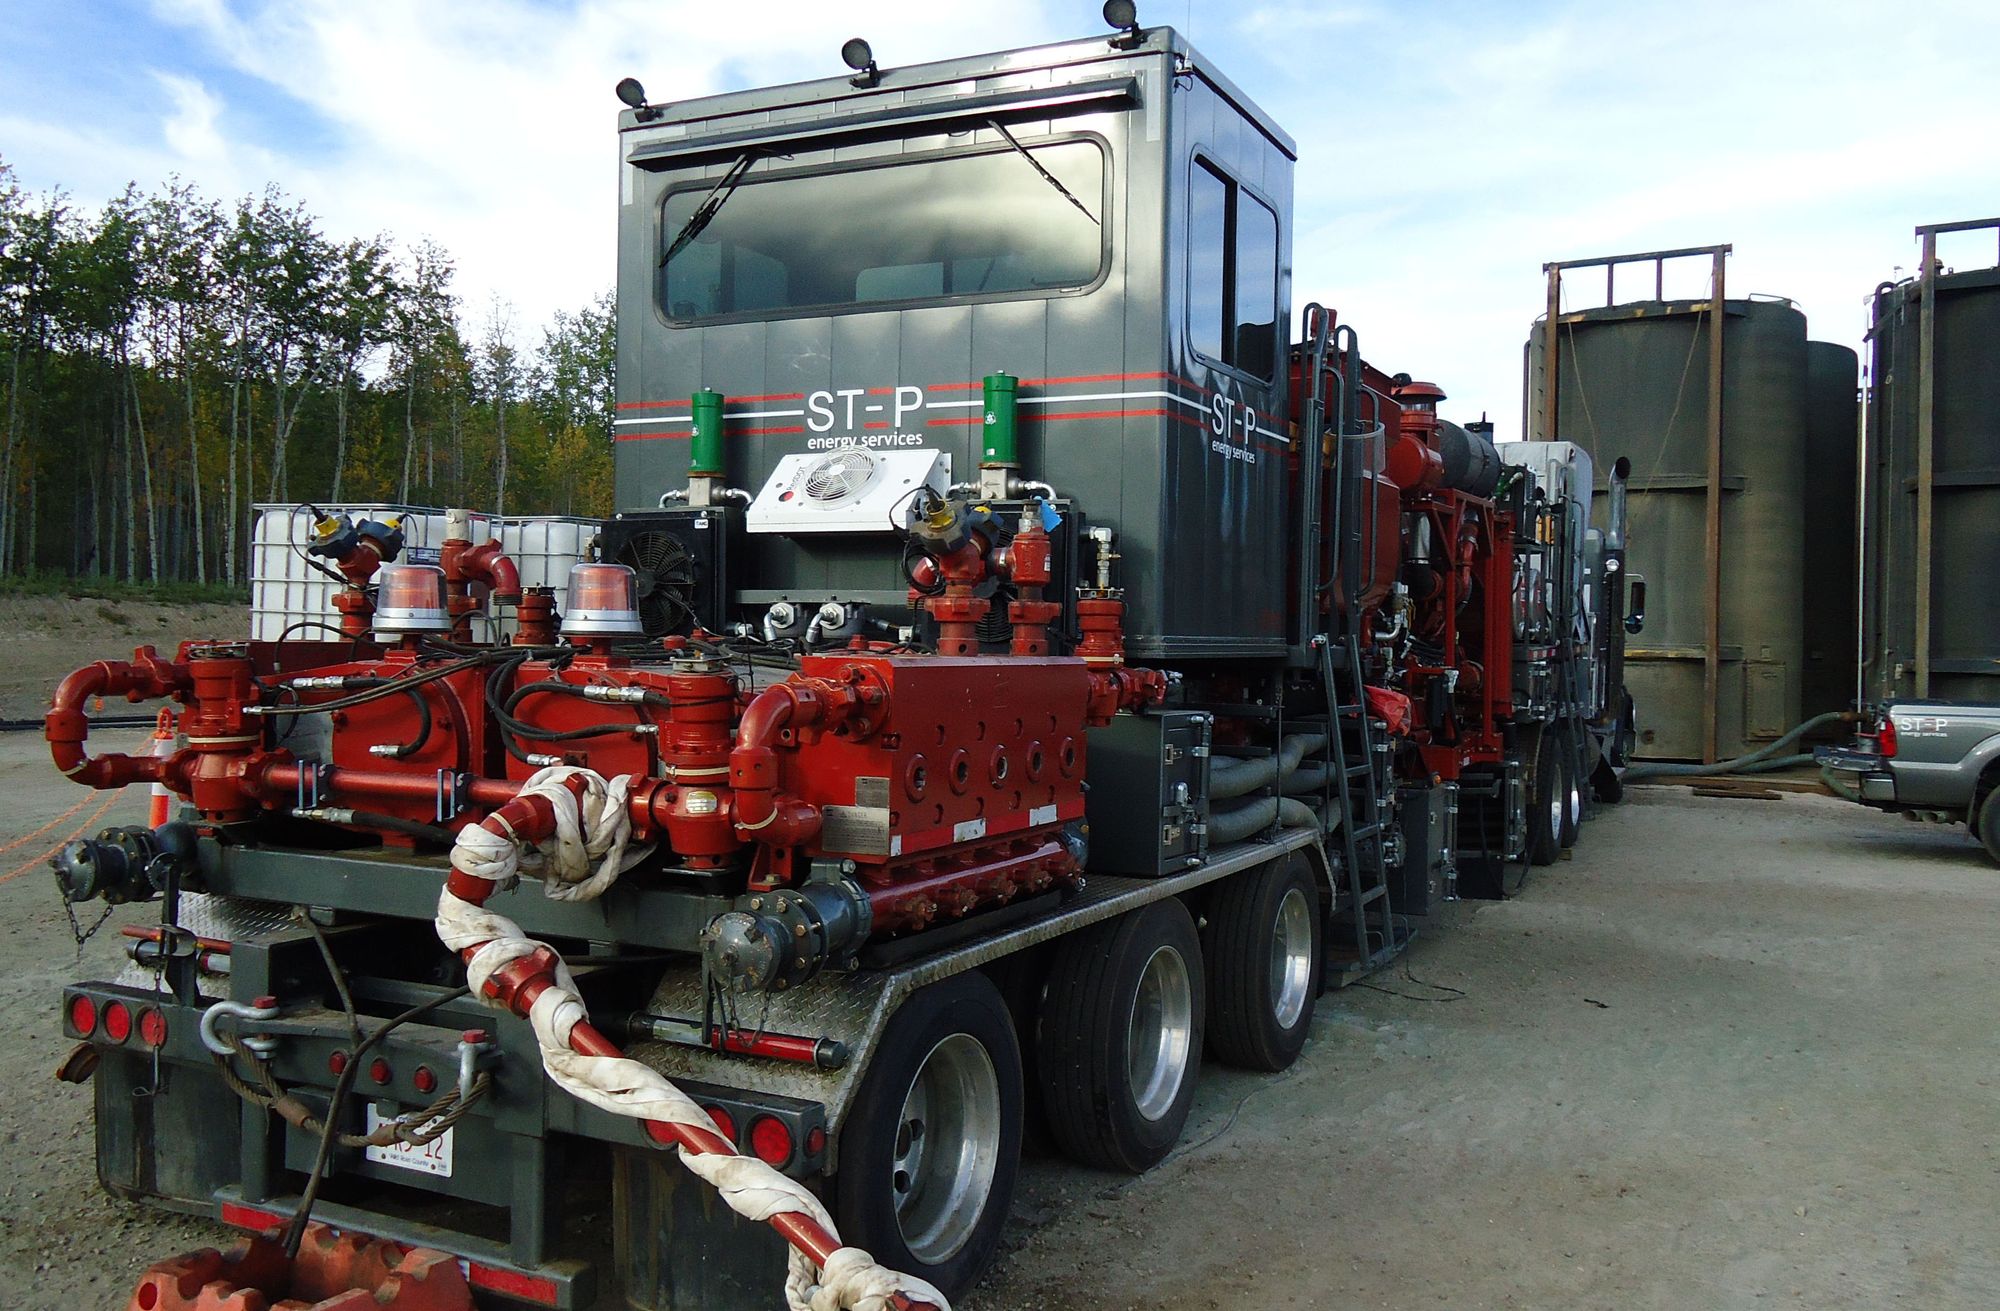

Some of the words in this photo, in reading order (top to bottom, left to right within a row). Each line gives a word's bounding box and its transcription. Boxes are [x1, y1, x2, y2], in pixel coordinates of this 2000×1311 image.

[807, 386, 924, 432] STEP
[807, 436, 857, 449] energy
[861, 431, 923, 447] services
[1212, 440, 1232, 459] energy
[1232, 447, 1256, 464] services
